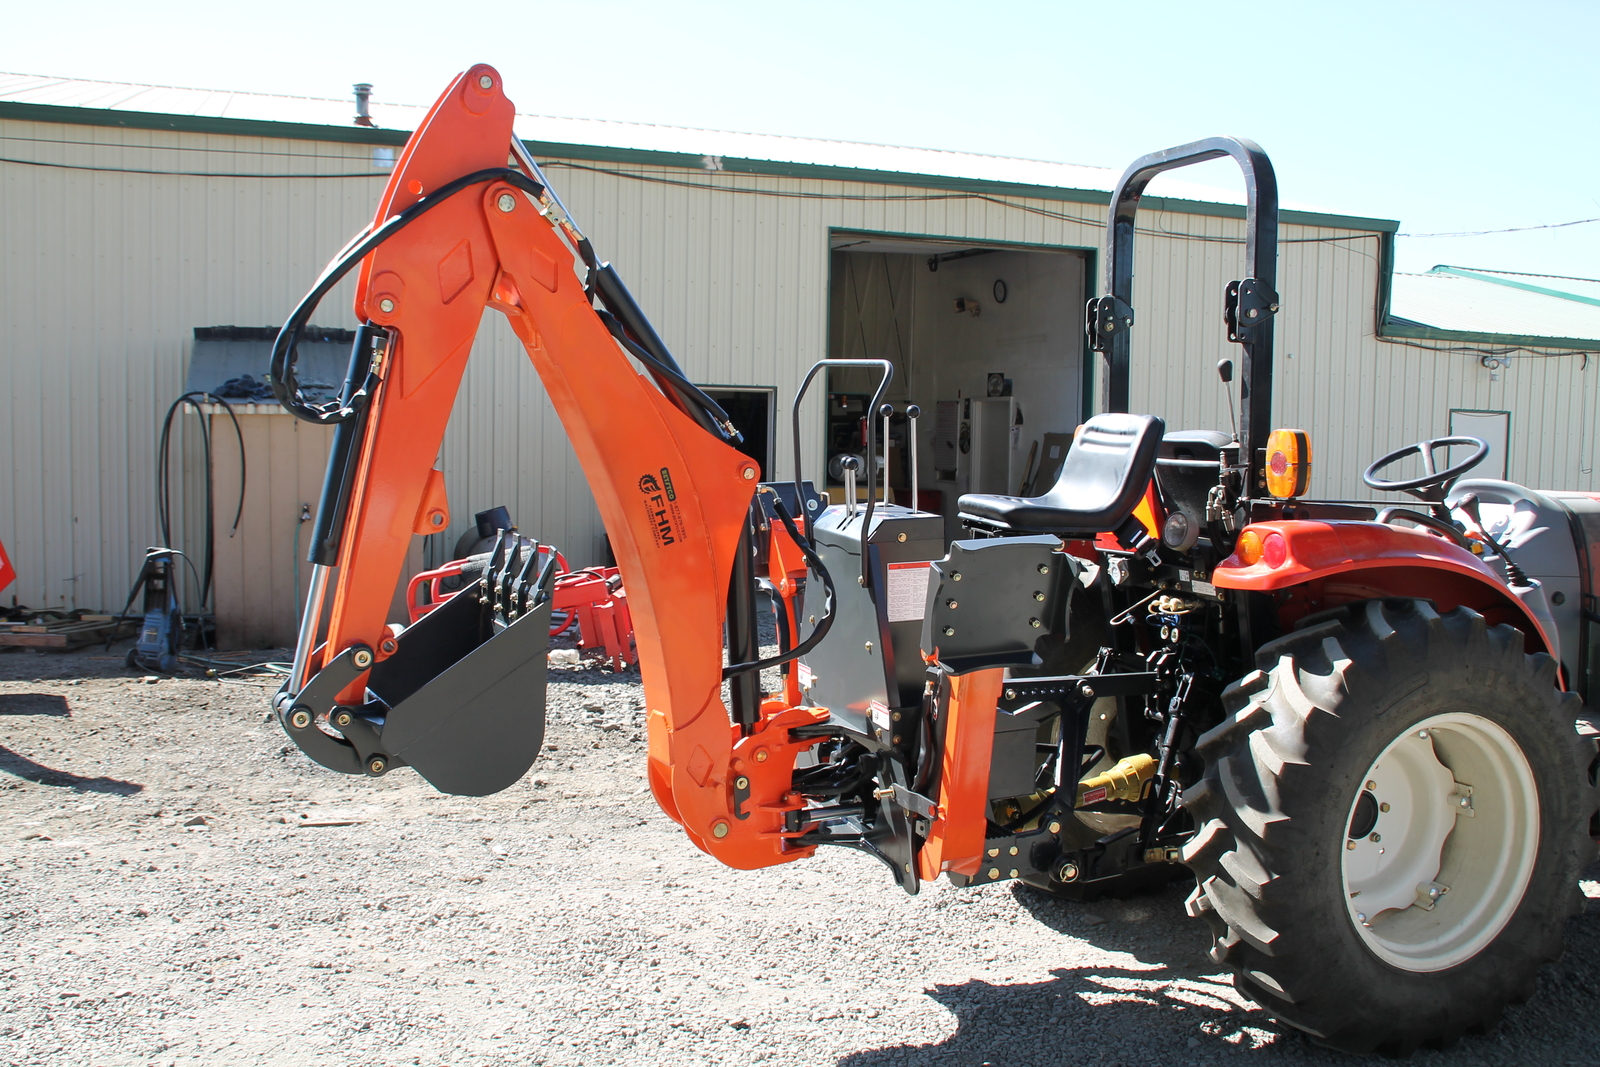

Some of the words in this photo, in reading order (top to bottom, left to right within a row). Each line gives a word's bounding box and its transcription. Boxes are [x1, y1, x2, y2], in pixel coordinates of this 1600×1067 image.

[643, 499, 653, 526] MACHINERY
[651, 526, 660, 549] COMPANY
[650, 494, 675, 546] FHM
